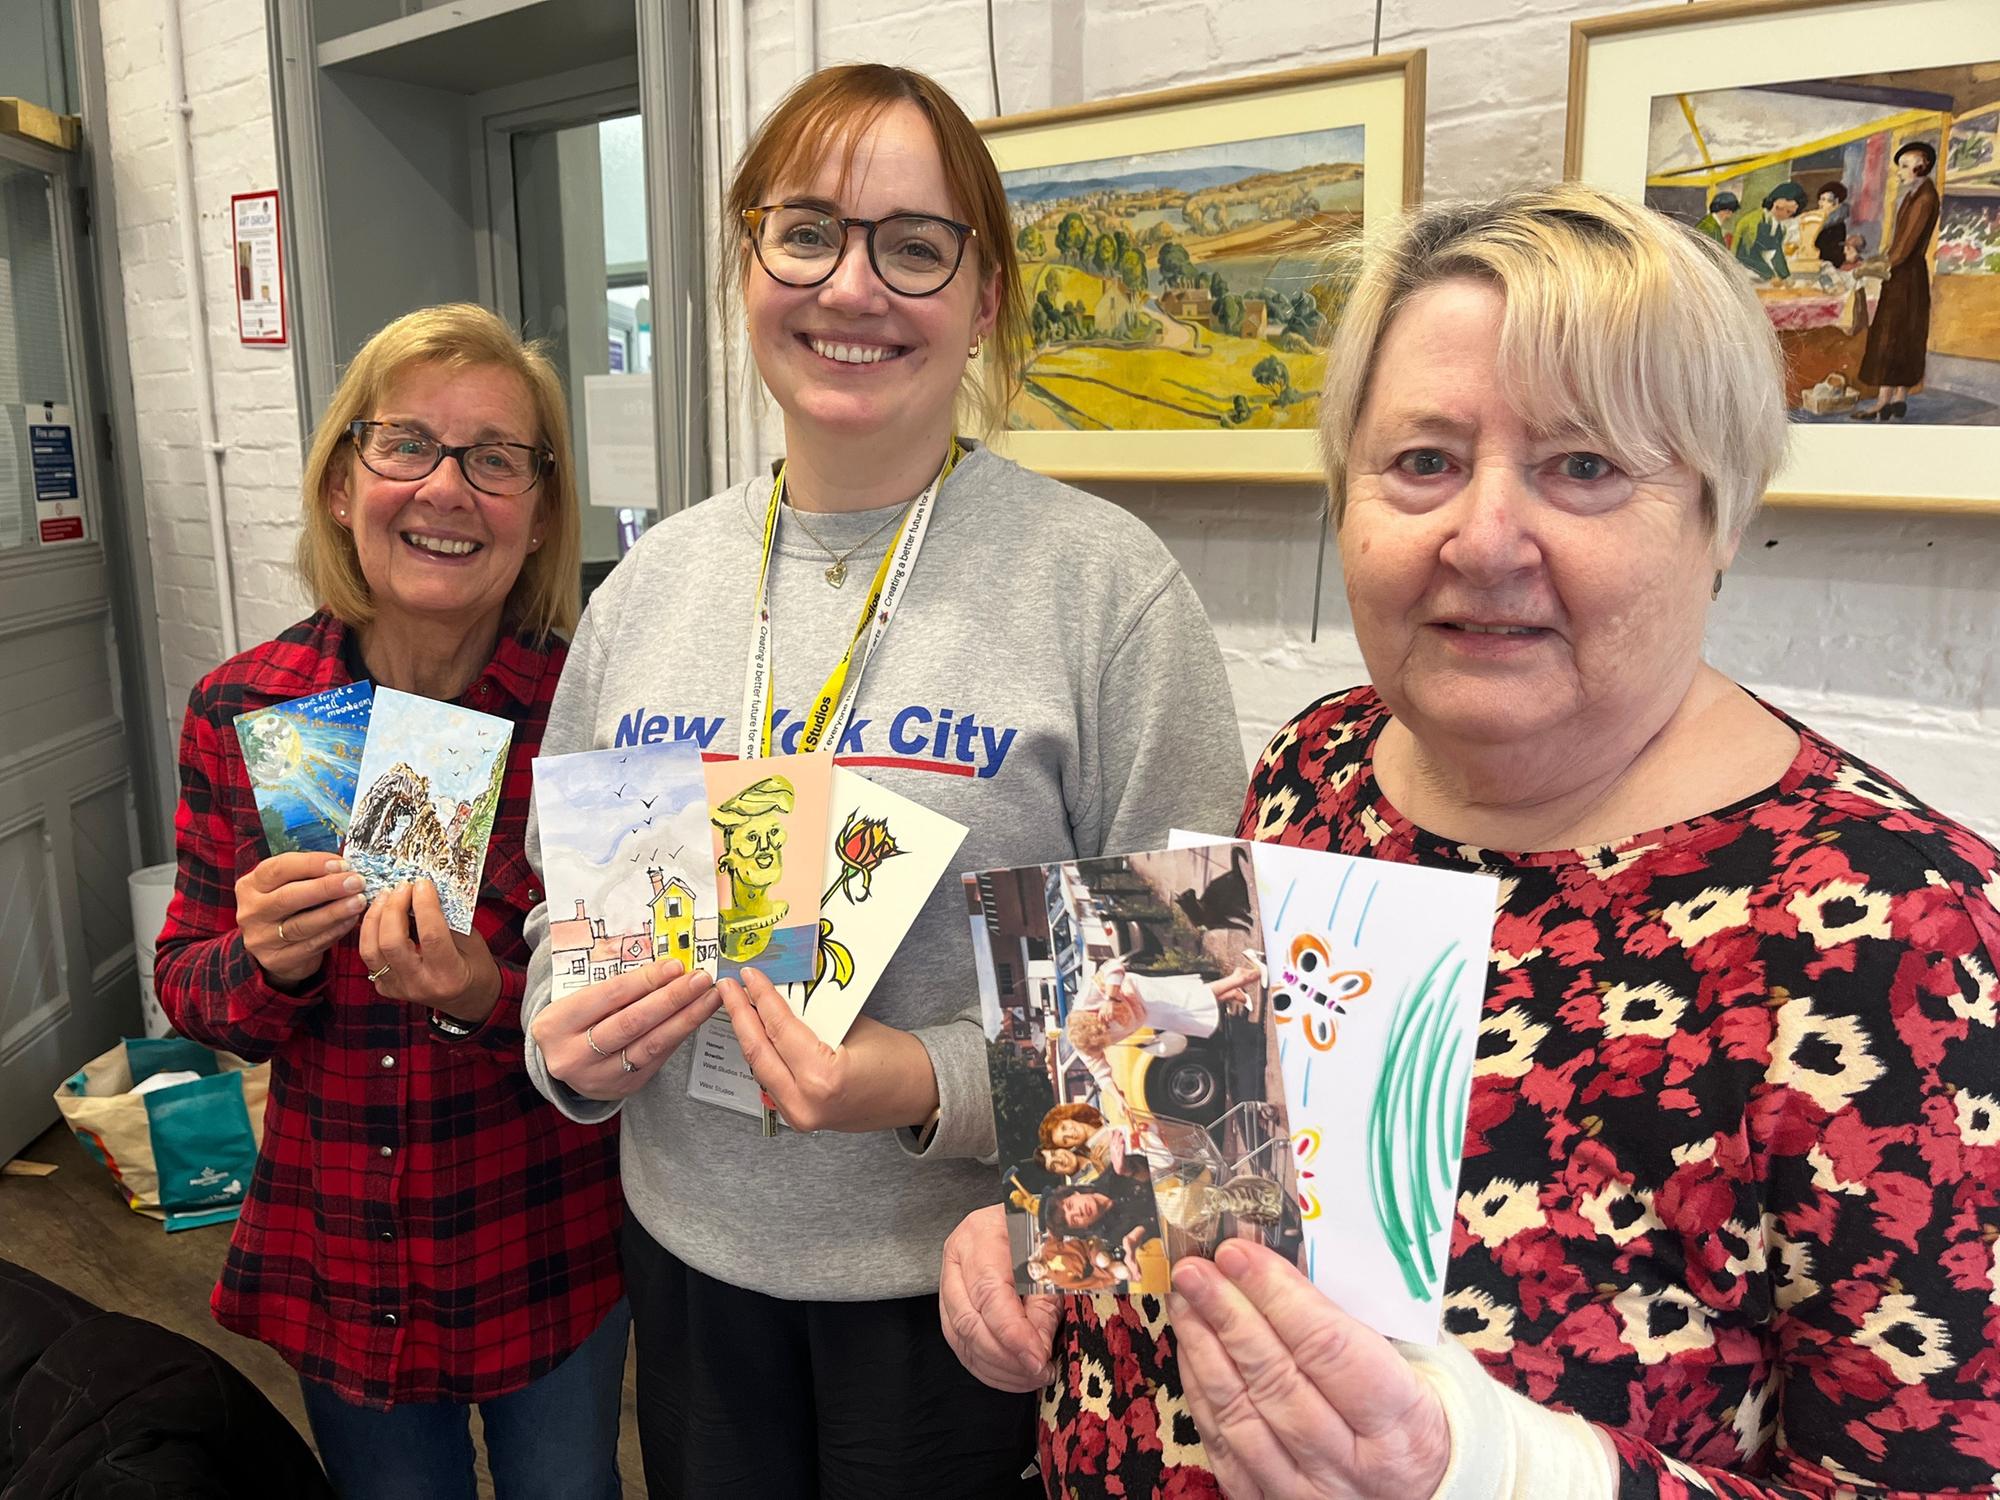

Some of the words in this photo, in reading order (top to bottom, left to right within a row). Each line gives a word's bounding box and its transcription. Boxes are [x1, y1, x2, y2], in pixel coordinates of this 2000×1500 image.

[884, 569, 906, 607] Creating
[900, 533, 916, 561] better
[911, 507, 925, 534] future
[755, 626, 768, 662] Creating
[319, 687, 345, 702] forget
[754, 671, 766, 698] better
[313, 700, 340, 713] small
[750, 700, 762, 727] future
[806, 697, 831, 746] Studios
[614, 707, 726, 752] New
[771, 709, 873, 756] ok
[889, 705, 1018, 779] City
[748, 729, 758, 743] for
[703, 1061, 717, 1071] West
[718, 1066, 738, 1077] Studios
[699, 1081, 714, 1090] West
[715, 1085, 735, 1096] Studios
